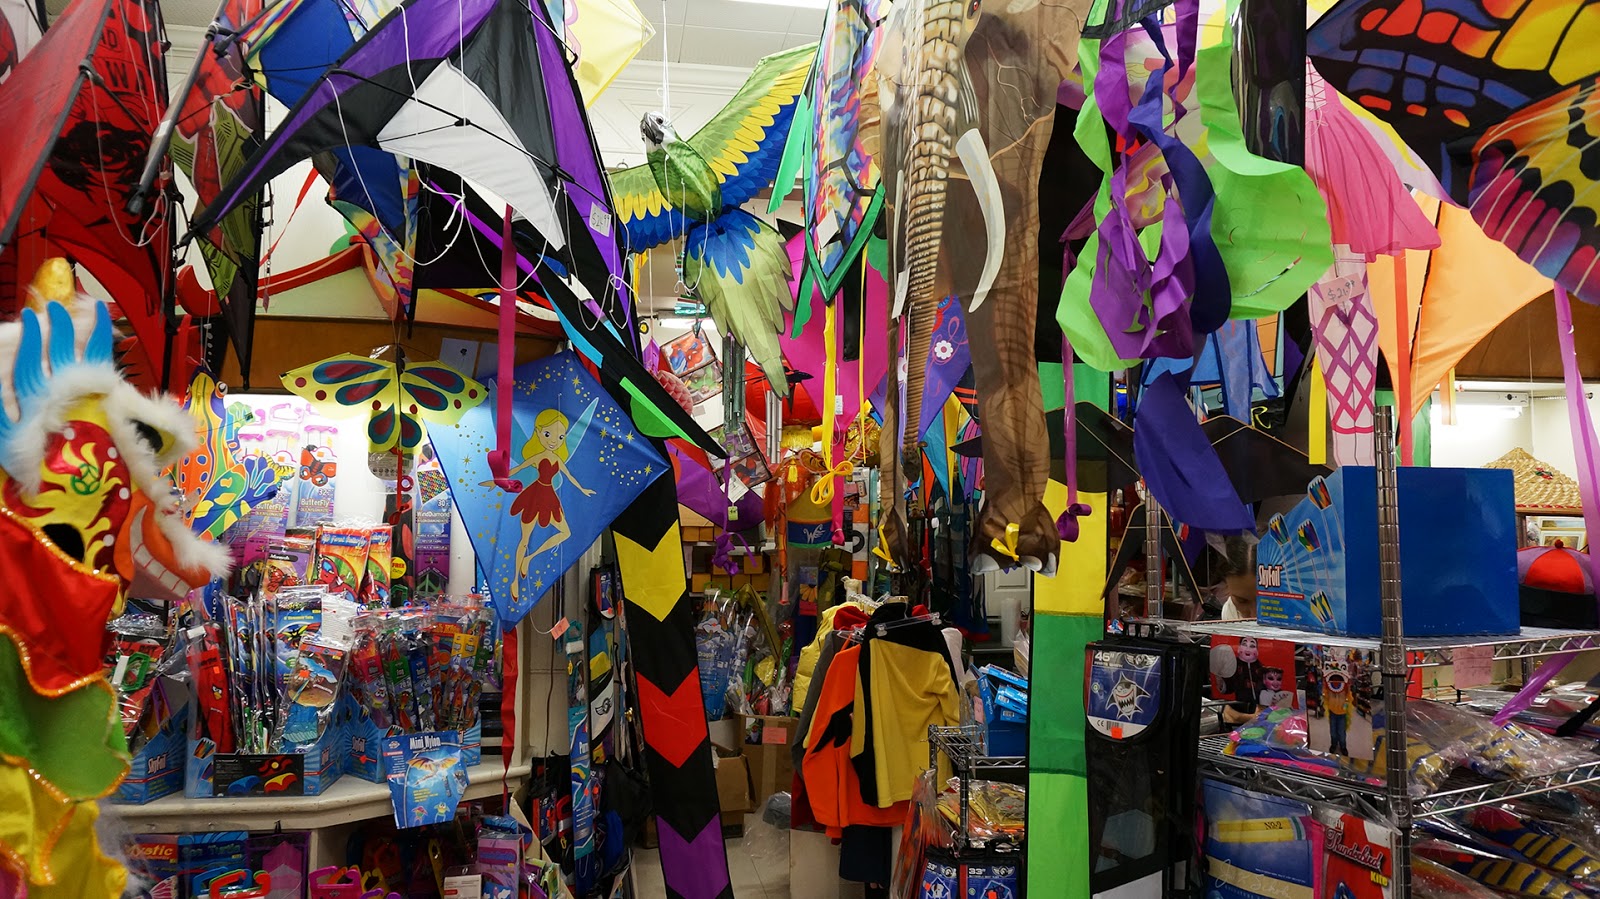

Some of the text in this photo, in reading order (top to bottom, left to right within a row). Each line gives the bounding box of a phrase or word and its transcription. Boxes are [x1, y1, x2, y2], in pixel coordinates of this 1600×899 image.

[1257, 564, 1282, 588] SkyFoil
[409, 735, 442, 750] Mini Nylon
[147, 754, 168, 775] SkyFoil
[1326, 827, 1384, 875] Thunderbird
[968, 867, 986, 875] 33"
